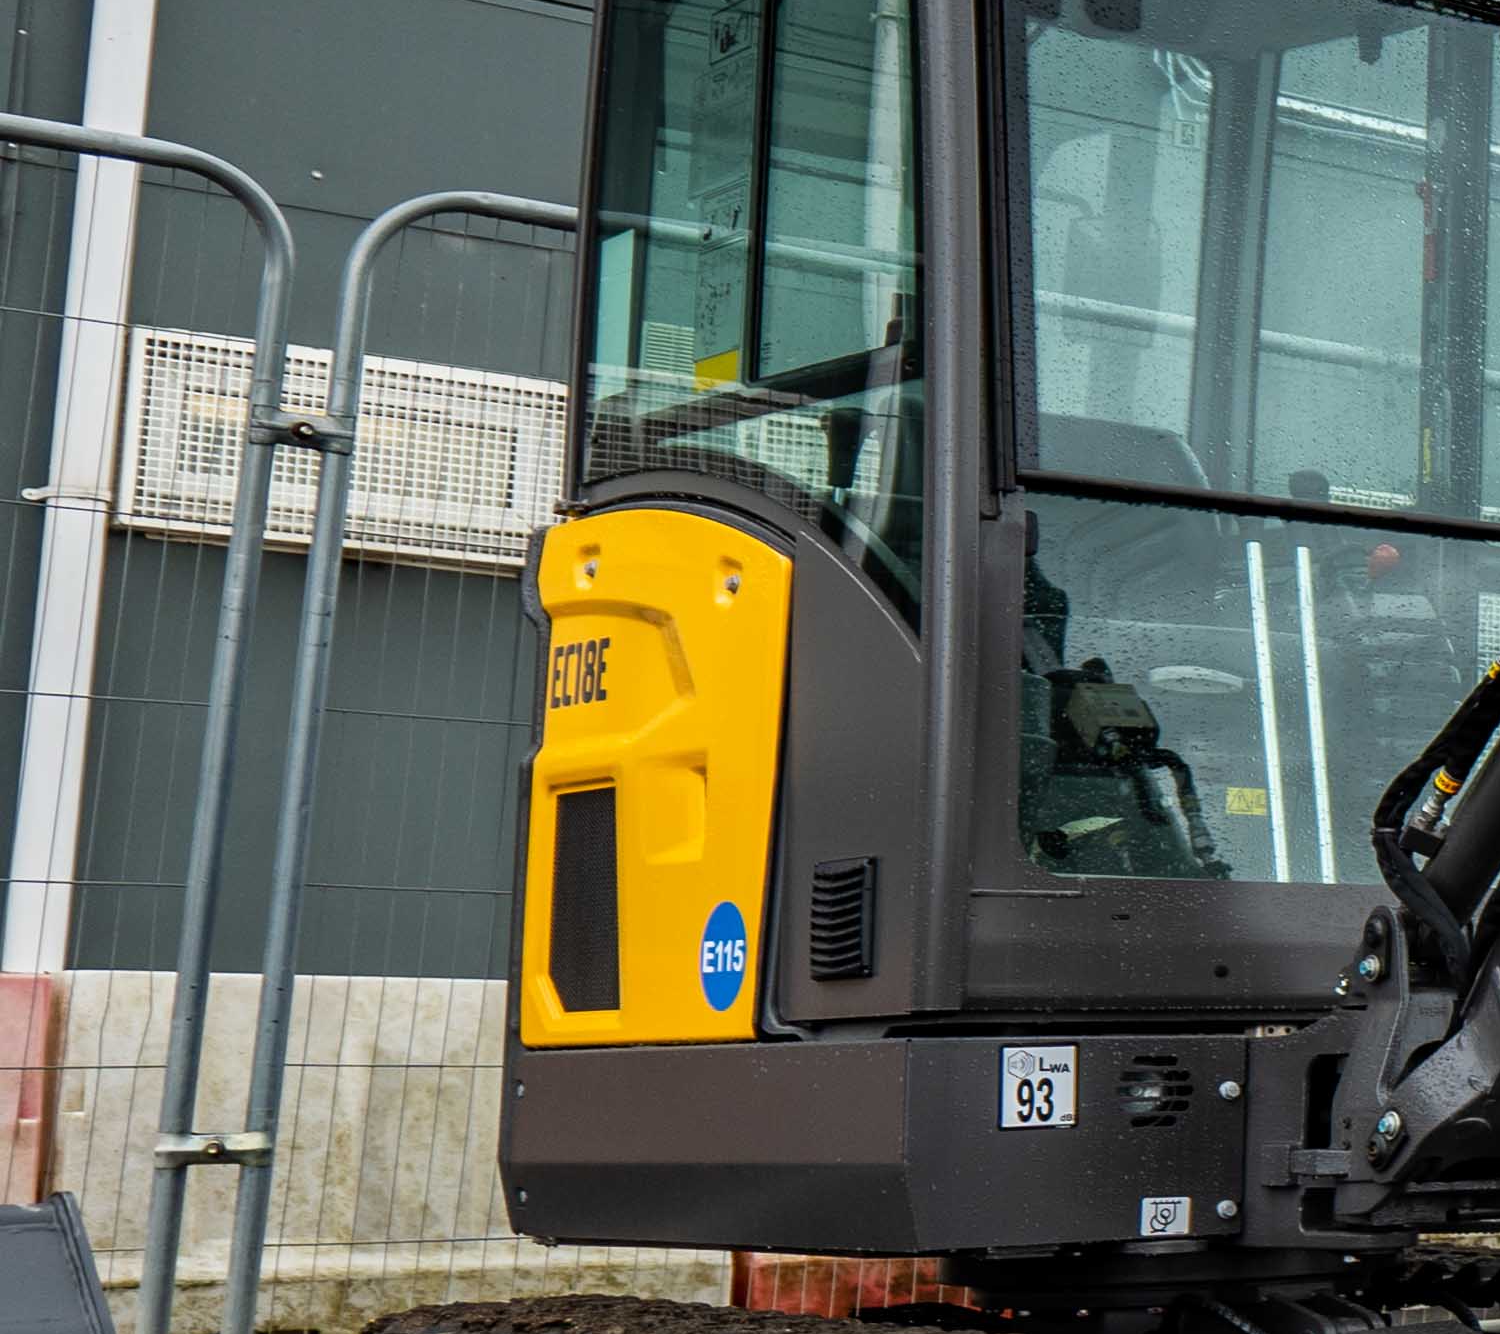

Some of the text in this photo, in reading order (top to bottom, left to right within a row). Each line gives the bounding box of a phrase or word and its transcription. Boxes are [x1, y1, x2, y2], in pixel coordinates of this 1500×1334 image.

[550, 637, 610, 709] EC18E
[702, 939, 745, 973] E115
[1016, 1077, 1055, 1123] 93
